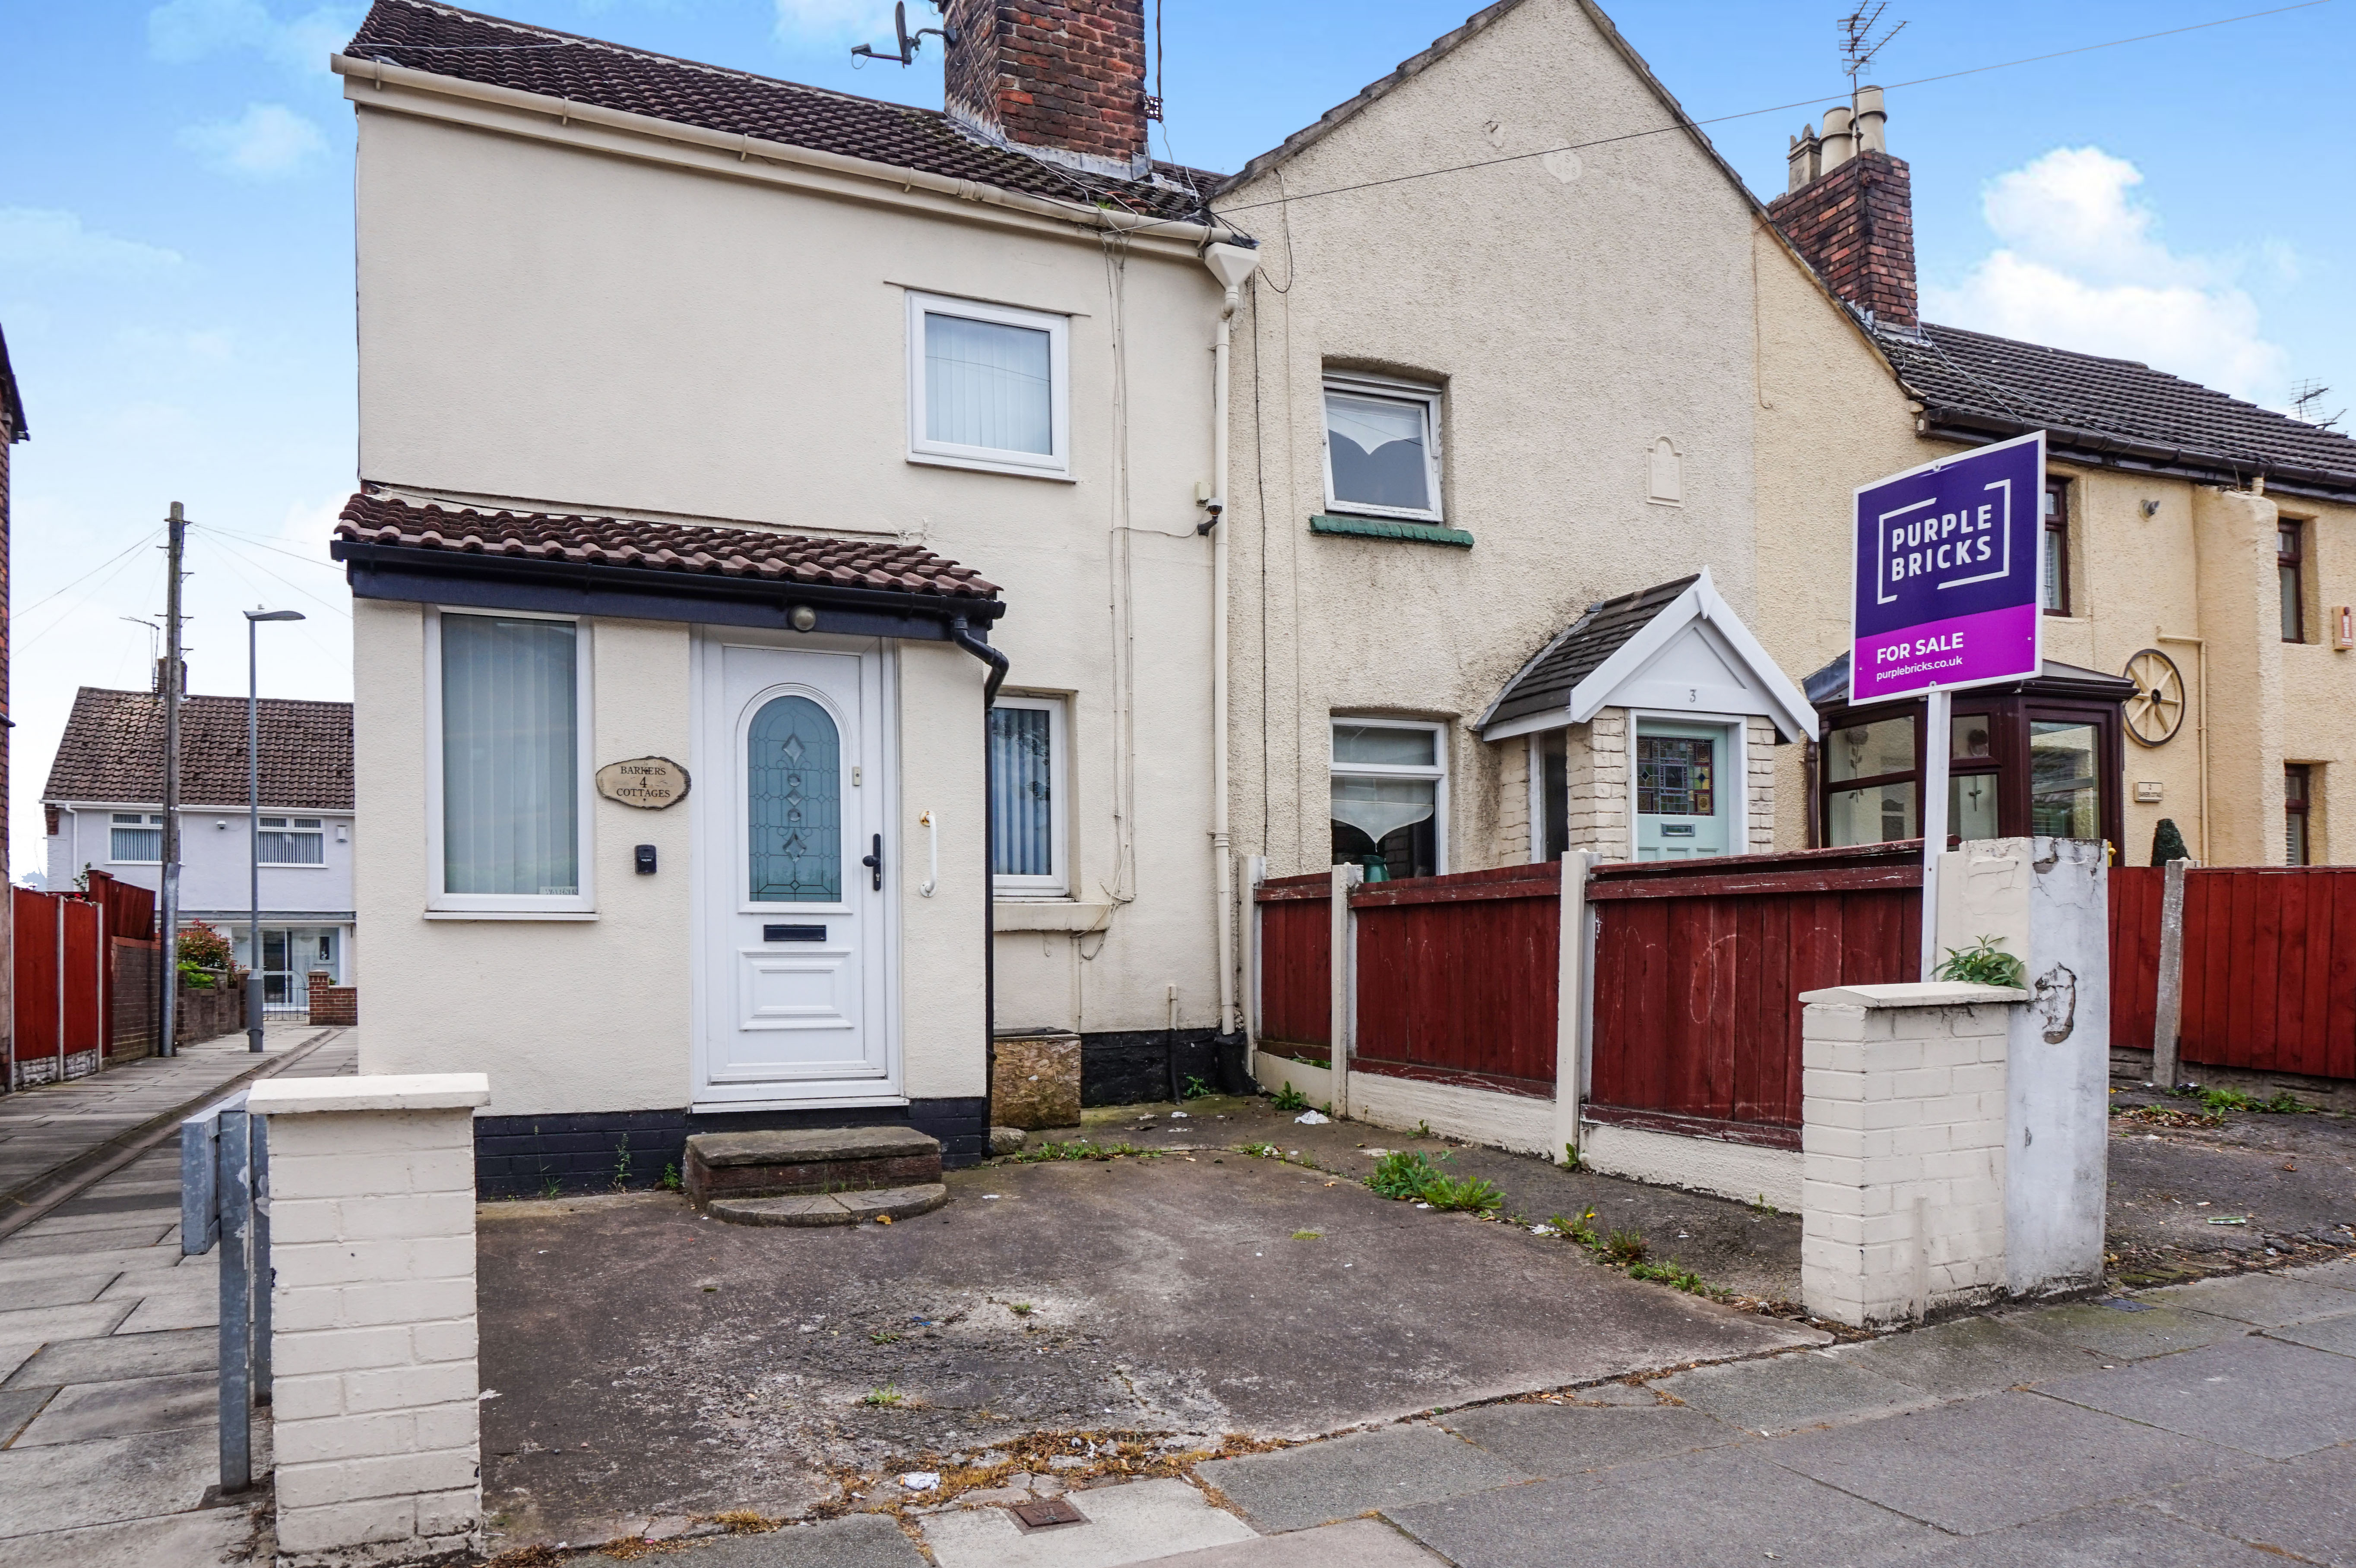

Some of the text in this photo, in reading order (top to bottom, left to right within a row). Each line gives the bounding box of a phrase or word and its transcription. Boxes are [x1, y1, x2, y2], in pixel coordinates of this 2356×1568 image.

[1892, 504, 1992, 552] PURPLE
[1892, 536, 1992, 582] BRICKS
[1877, 632, 1964, 664] FOR SALE
[1876, 655, 1963, 682] purplebricks.co.uk
[1689, 689, 1697, 703] 3
[621, 766, 666, 775] BARKERS
[639, 776, 648, 788] 4
[616, 788, 671, 798] COTTAGES
